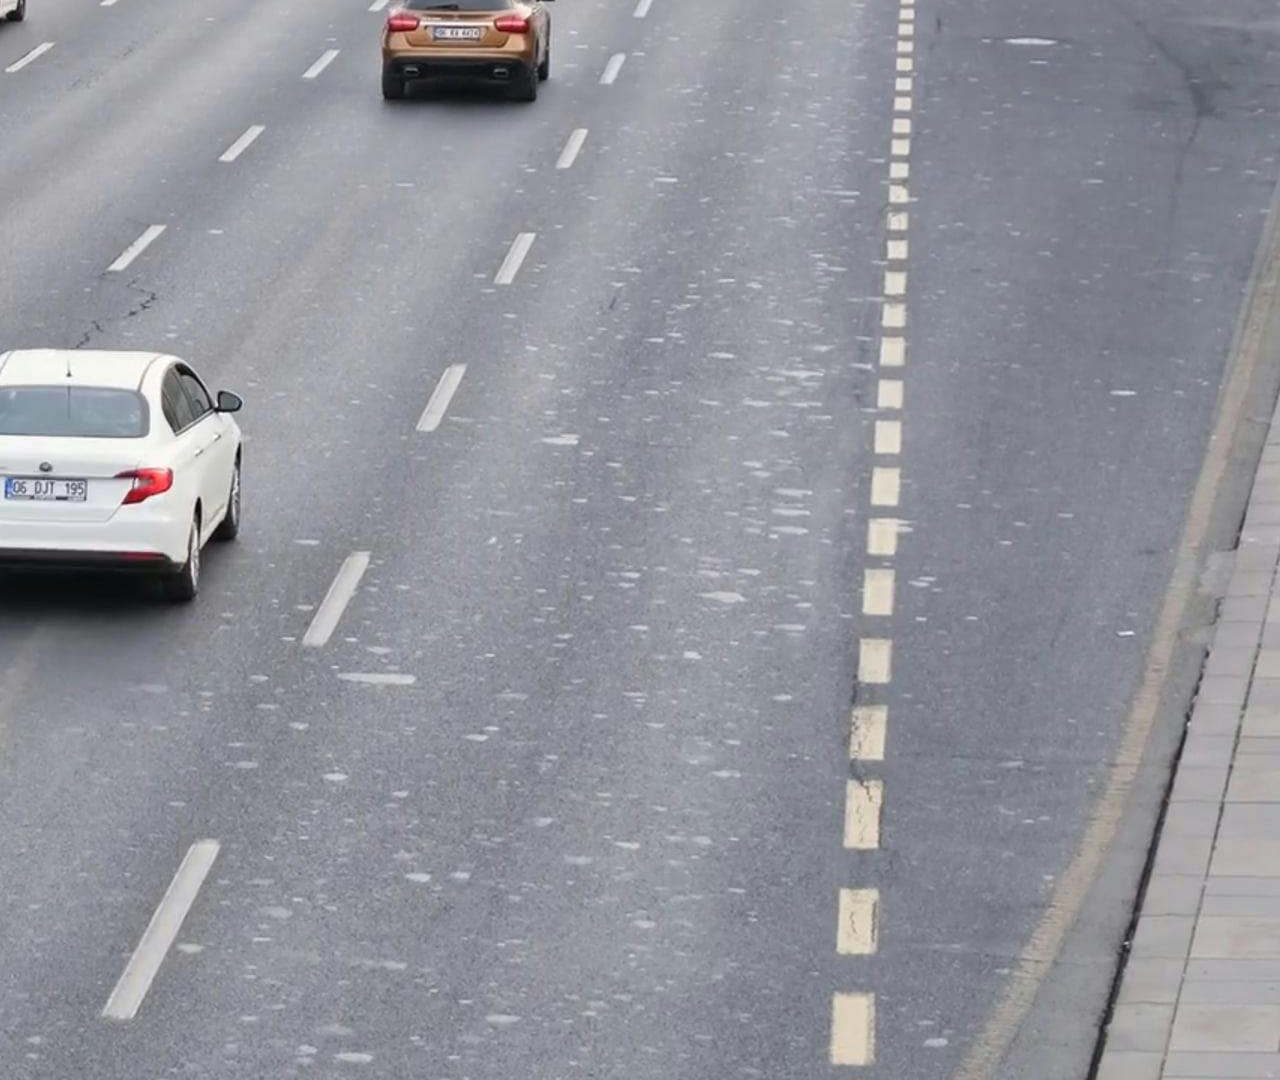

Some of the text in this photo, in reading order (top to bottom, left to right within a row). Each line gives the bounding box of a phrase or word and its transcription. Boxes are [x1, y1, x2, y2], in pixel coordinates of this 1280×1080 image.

[13, 480, 84, 496] 06 DJT 195
